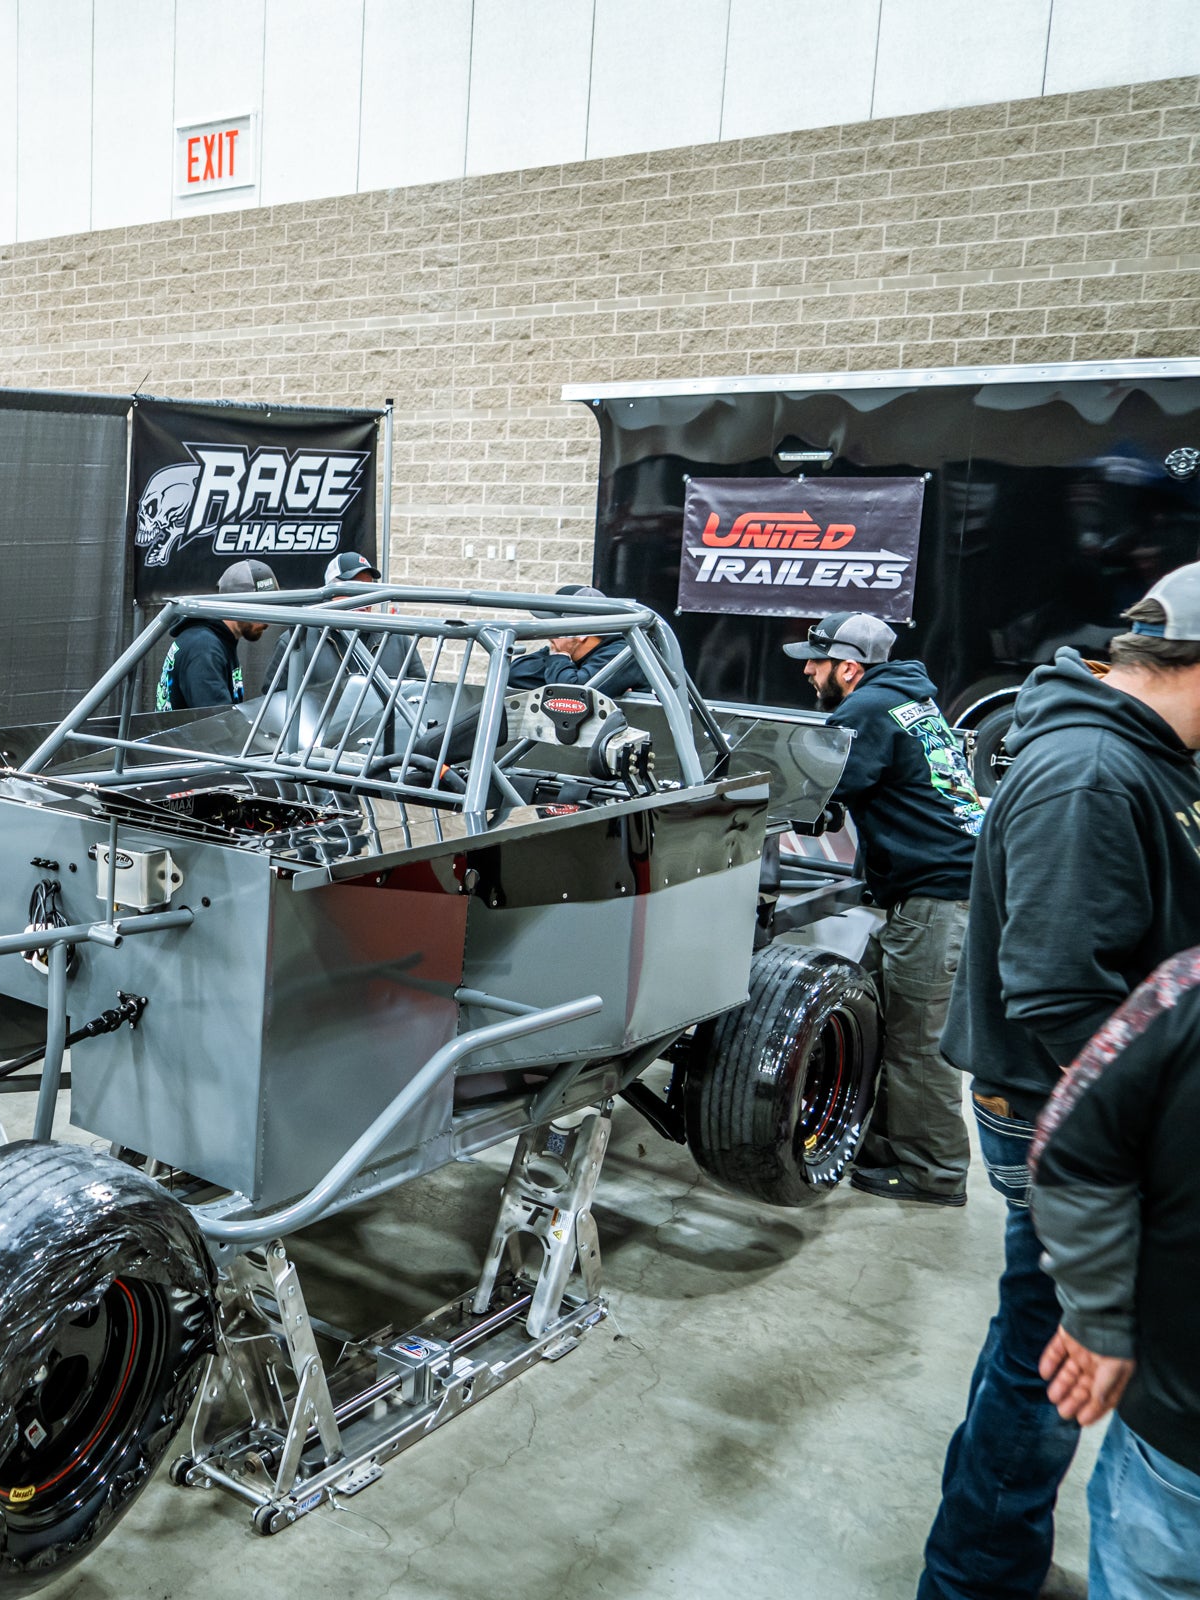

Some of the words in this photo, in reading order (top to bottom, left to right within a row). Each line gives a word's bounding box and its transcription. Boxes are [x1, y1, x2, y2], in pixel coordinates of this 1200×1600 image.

[187, 129, 239, 184] EXIT
[184, 449, 362, 537] RAGE
[215, 523, 340, 551] CHASSIS
[701, 510, 857, 550] UNITED
[687, 548, 912, 590] TRAILERS
[548, 701, 585, 710] KIRKEY
